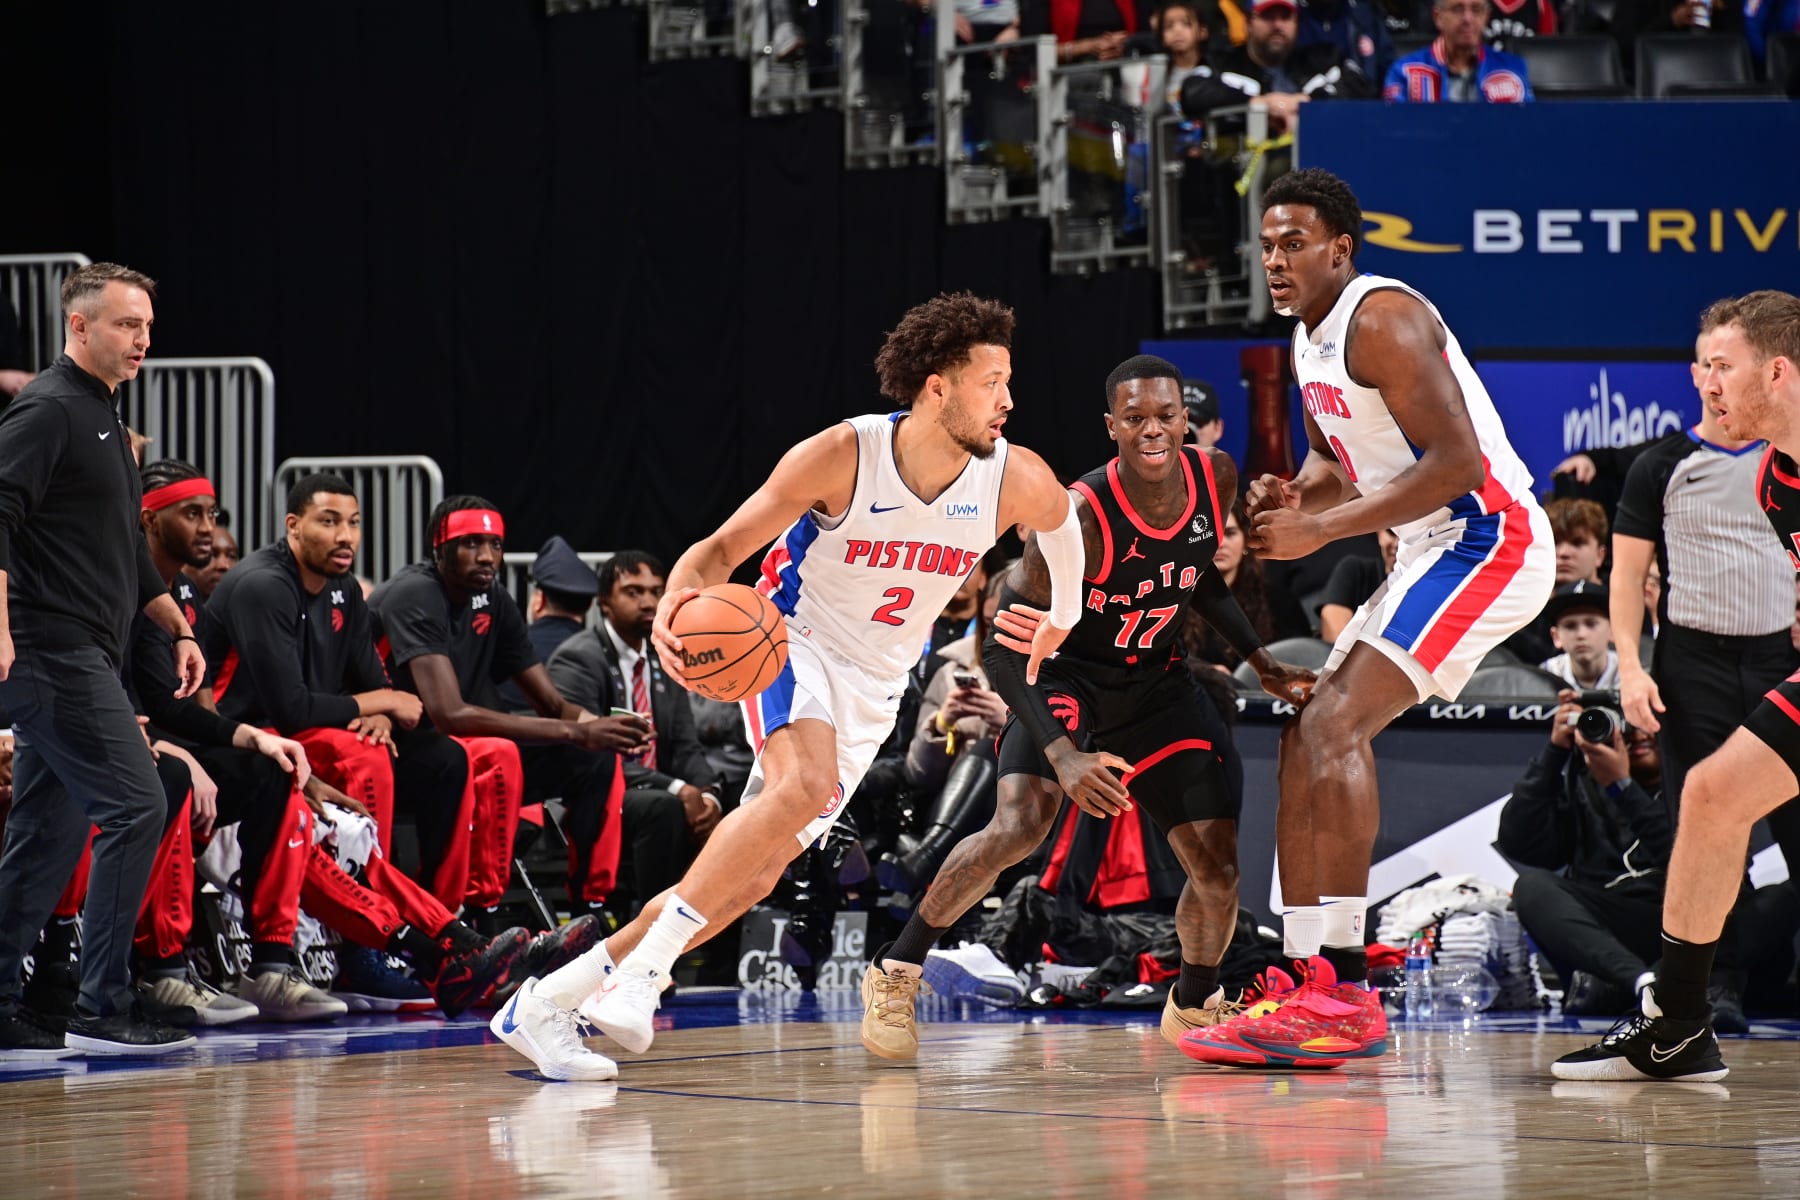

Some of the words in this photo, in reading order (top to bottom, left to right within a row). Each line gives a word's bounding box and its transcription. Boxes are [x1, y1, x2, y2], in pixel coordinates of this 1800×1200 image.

[1473, 209, 1800, 253] BETRIV
[1319, 341, 1336, 354] UWM
[1302, 381, 1352, 419] ISTONS
[946, 504, 978, 516] UWM
[844, 539, 979, 577] PISTONS
[1188, 535, 1202, 544] Sun
[871, 586, 915, 626] 2
[1114, 603, 1179, 648] 17
[1429, 704, 1486, 719] KIA
